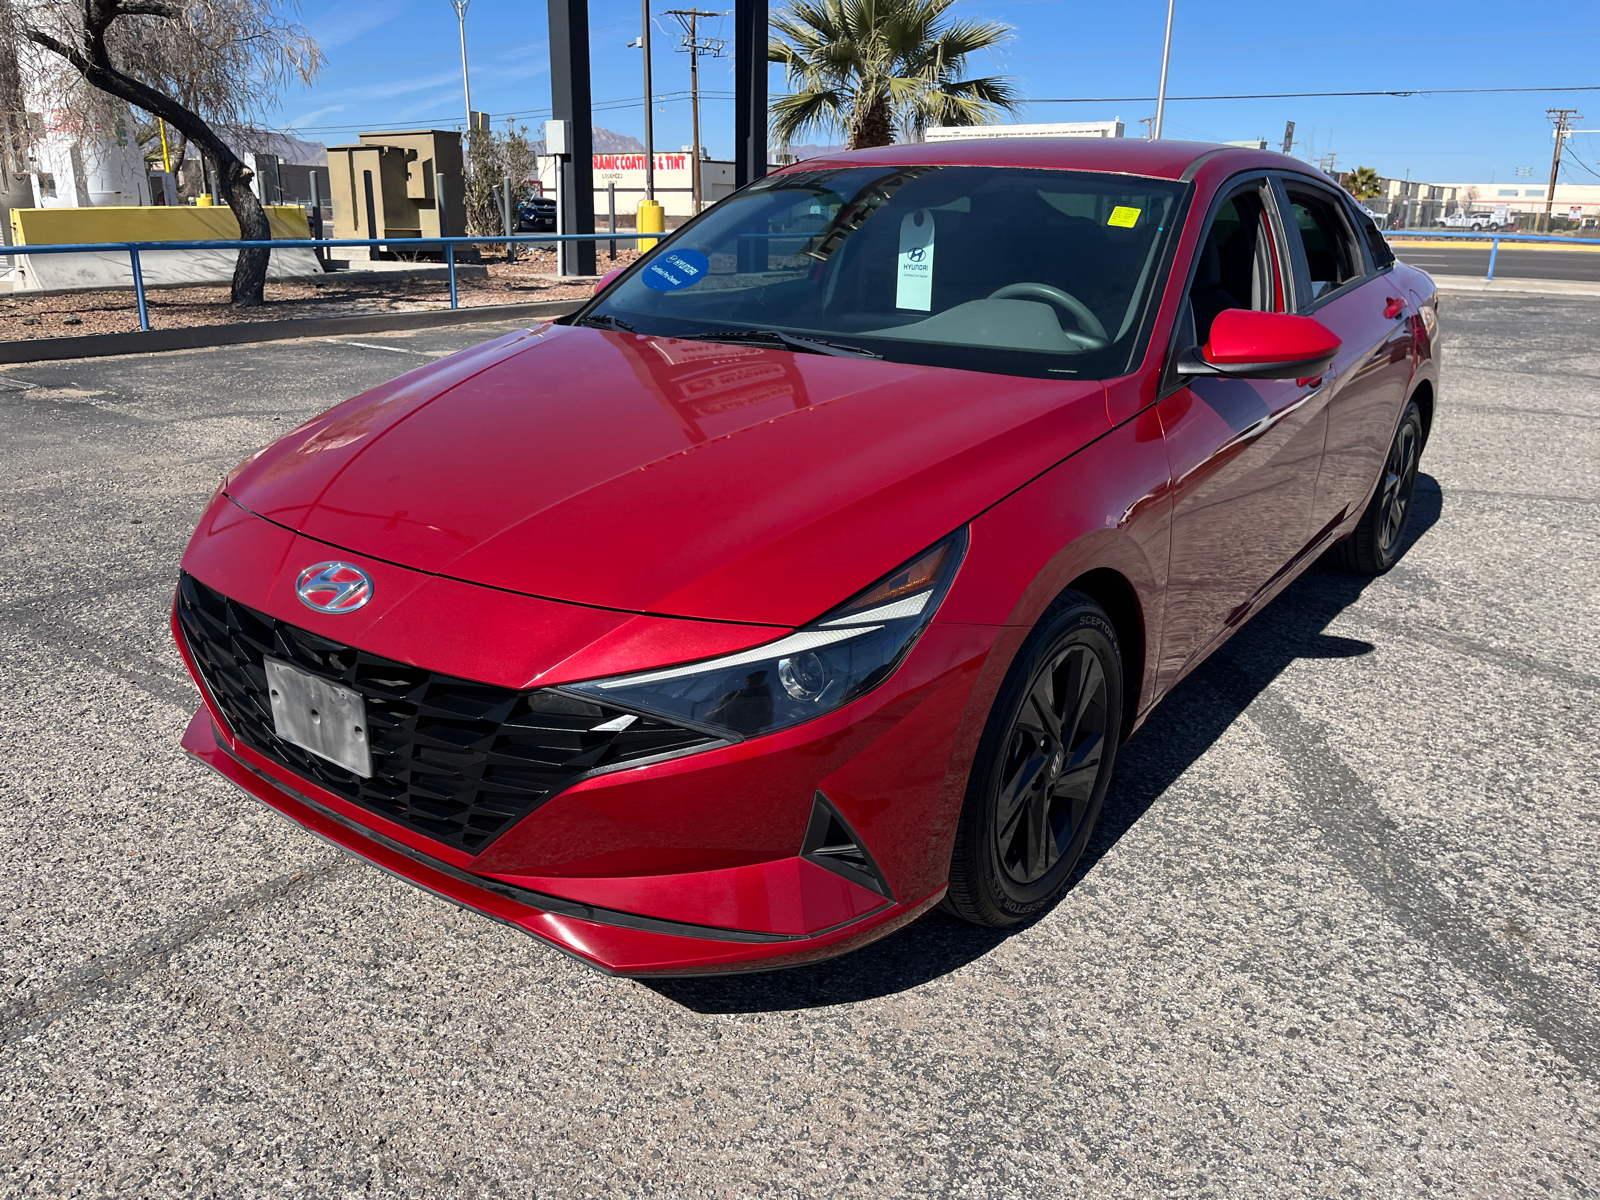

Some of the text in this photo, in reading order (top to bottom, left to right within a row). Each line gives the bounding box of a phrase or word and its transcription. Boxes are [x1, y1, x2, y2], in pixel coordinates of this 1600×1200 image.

[593, 155, 620, 170] RAMIC
[658, 155, 664, 170] &
[665, 155, 686, 170] TINT
[673, 258, 699, 276] HYUNDAI
[1079, 615, 1114, 641] SCEPTOR
[991, 876, 1005, 899] 4XS
[1004, 897, 1046, 914] SCEPTOR
